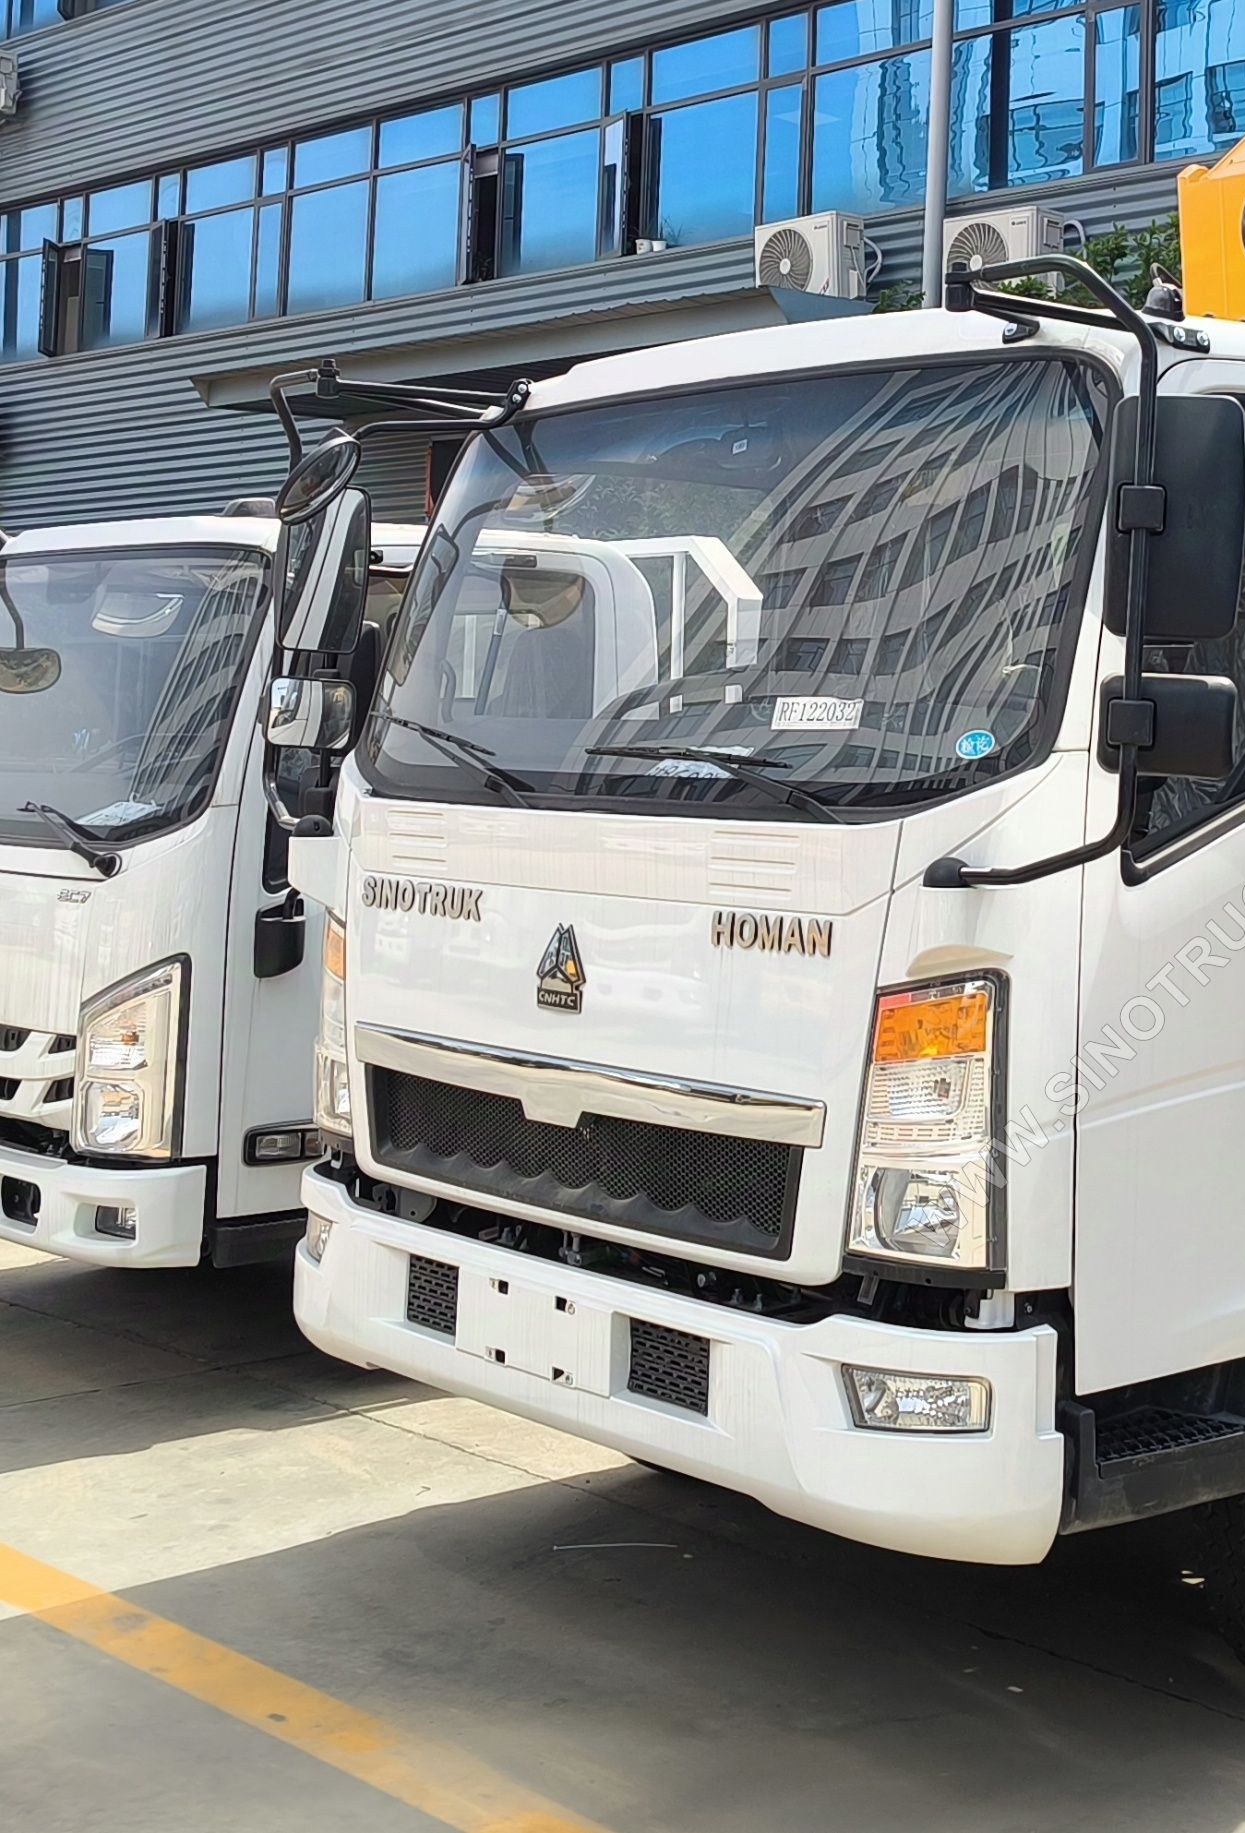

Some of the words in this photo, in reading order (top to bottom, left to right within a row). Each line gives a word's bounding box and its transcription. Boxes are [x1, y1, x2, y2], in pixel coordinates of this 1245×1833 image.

[778, 701, 857, 723] RF122032
[362, 875, 483, 922] SINOTRUK
[711, 910, 833, 959] HOMAN
[538, 991, 576, 1006] CNHTC
